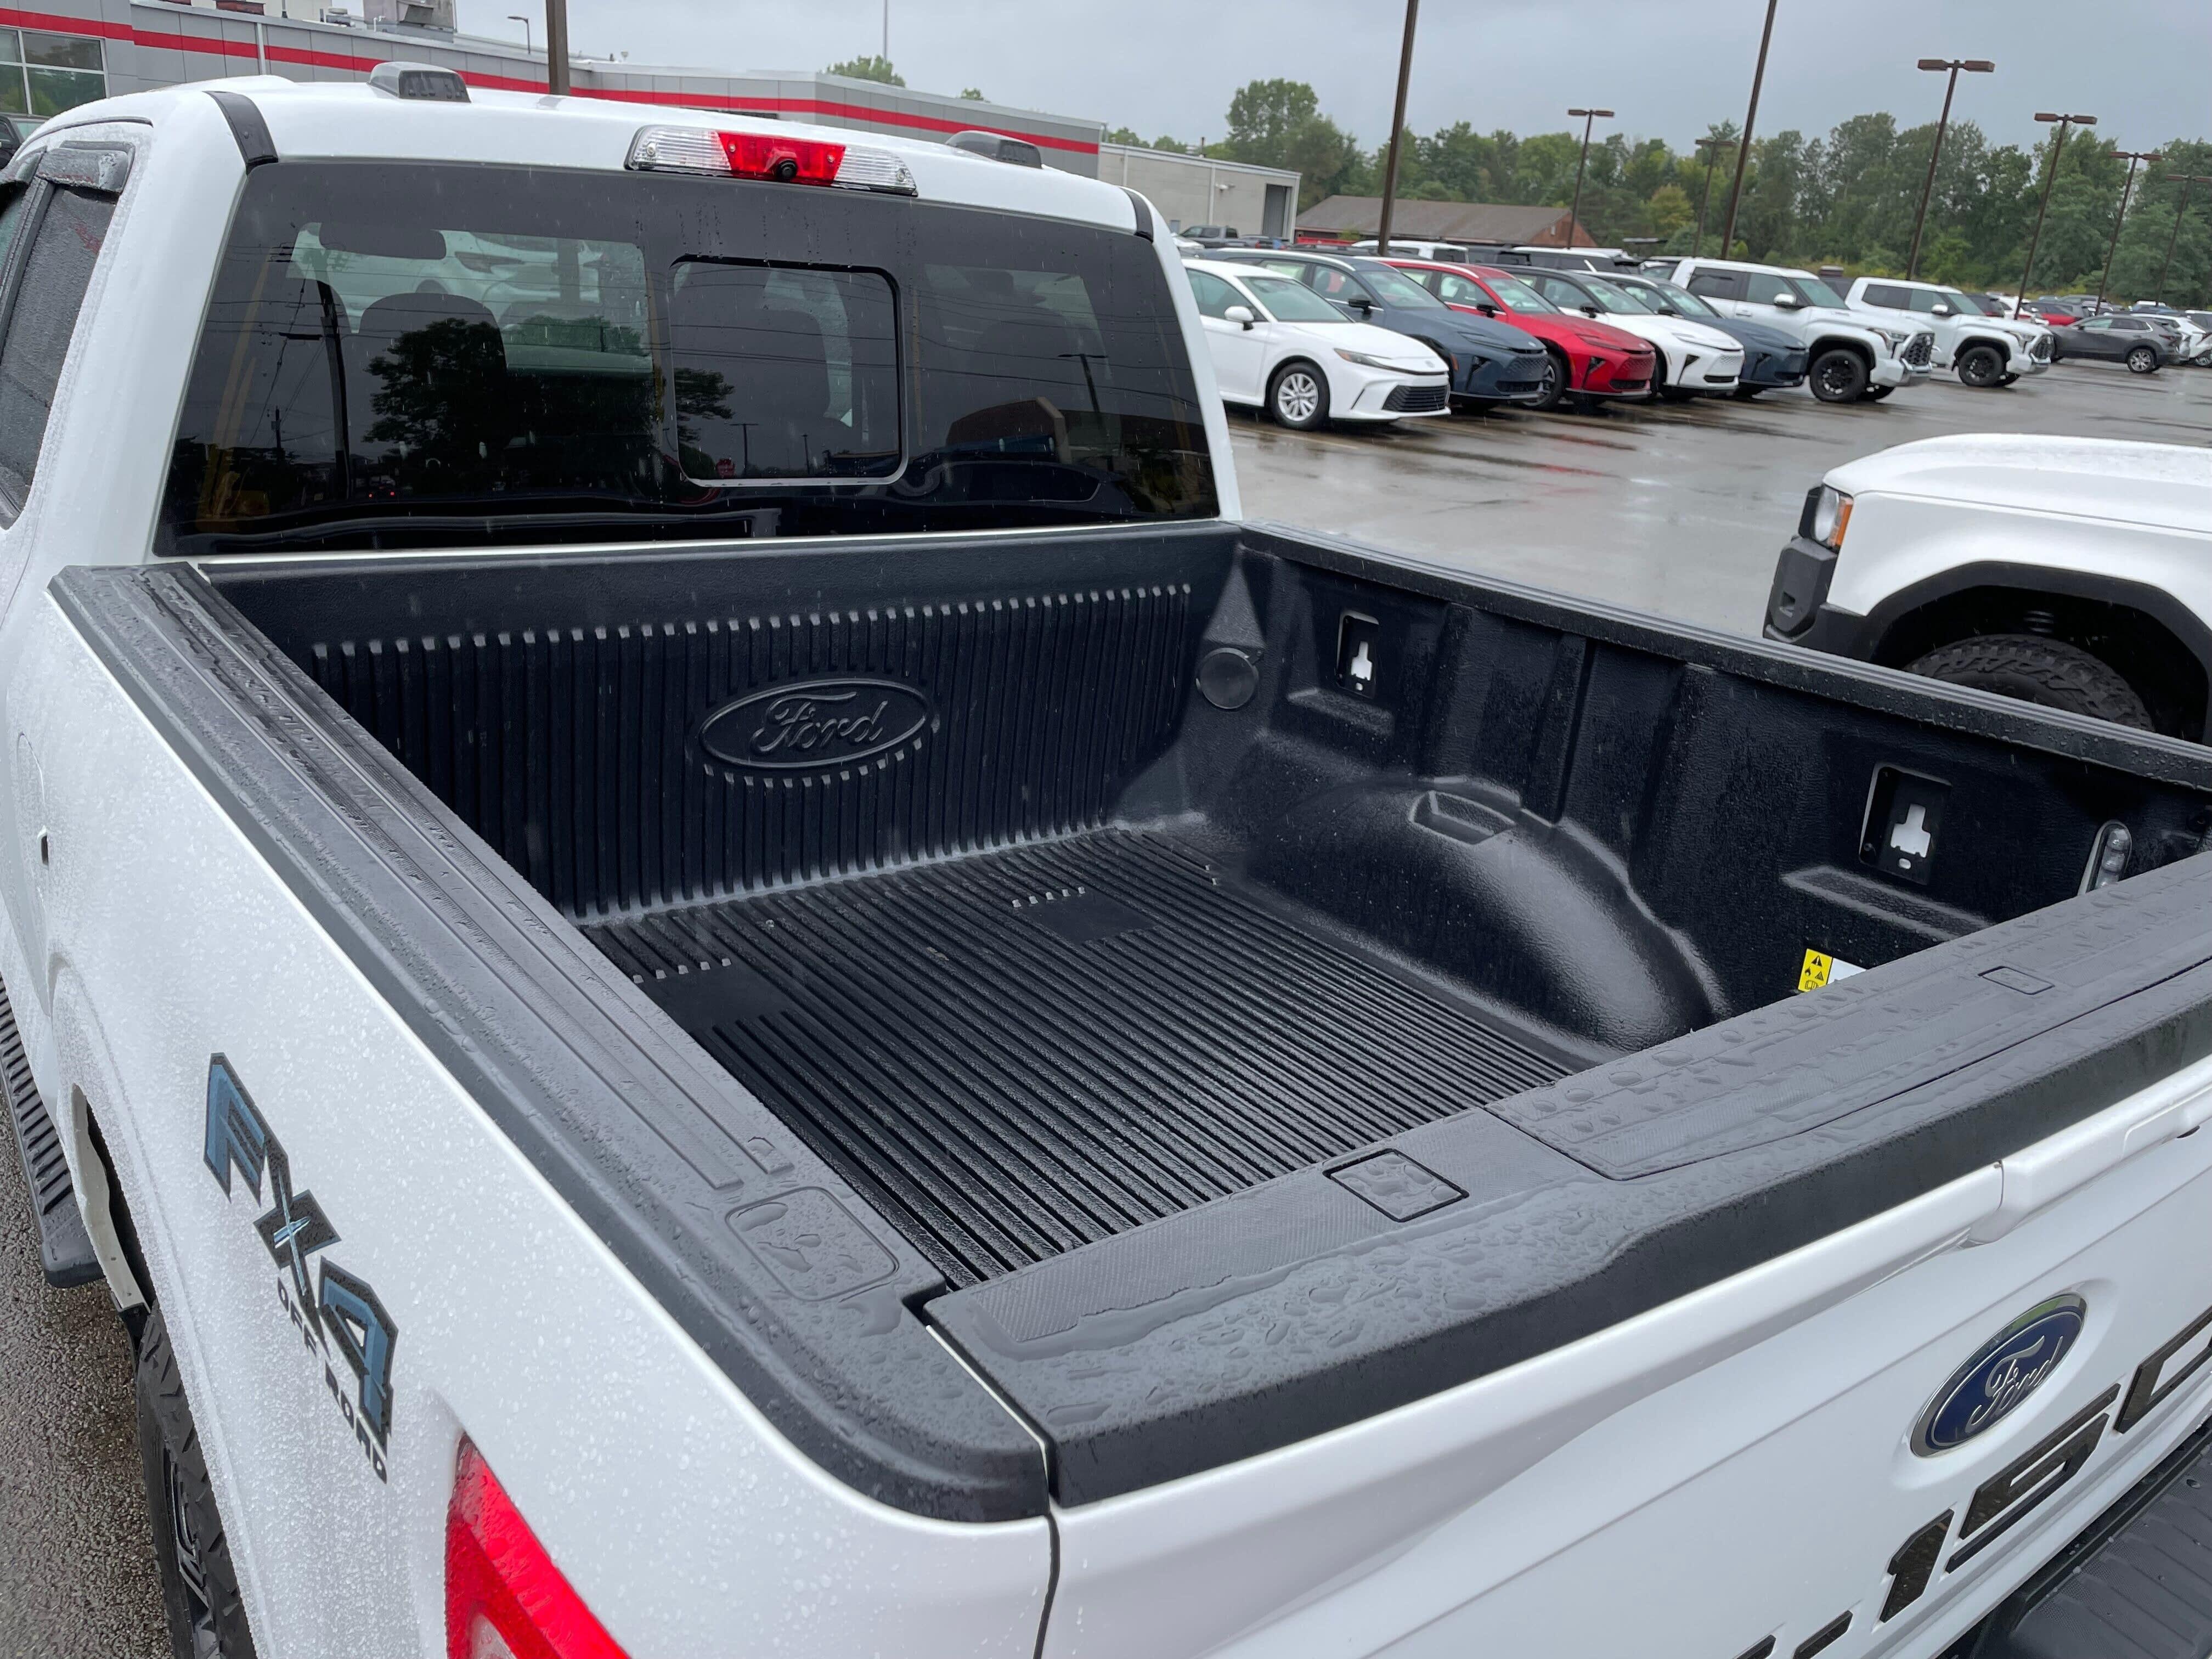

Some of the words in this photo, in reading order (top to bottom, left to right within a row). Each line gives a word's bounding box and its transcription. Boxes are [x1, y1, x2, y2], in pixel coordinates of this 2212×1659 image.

[751, 691, 888, 753] Ford
[202, 1052, 399, 1461] FX4
[277, 1277, 317, 1359] OFF
[325, 1359, 387, 1485] ROAD
[1726, 1305, 2212, 1659] -150
[1965, 1335, 2064, 1434] Ford
